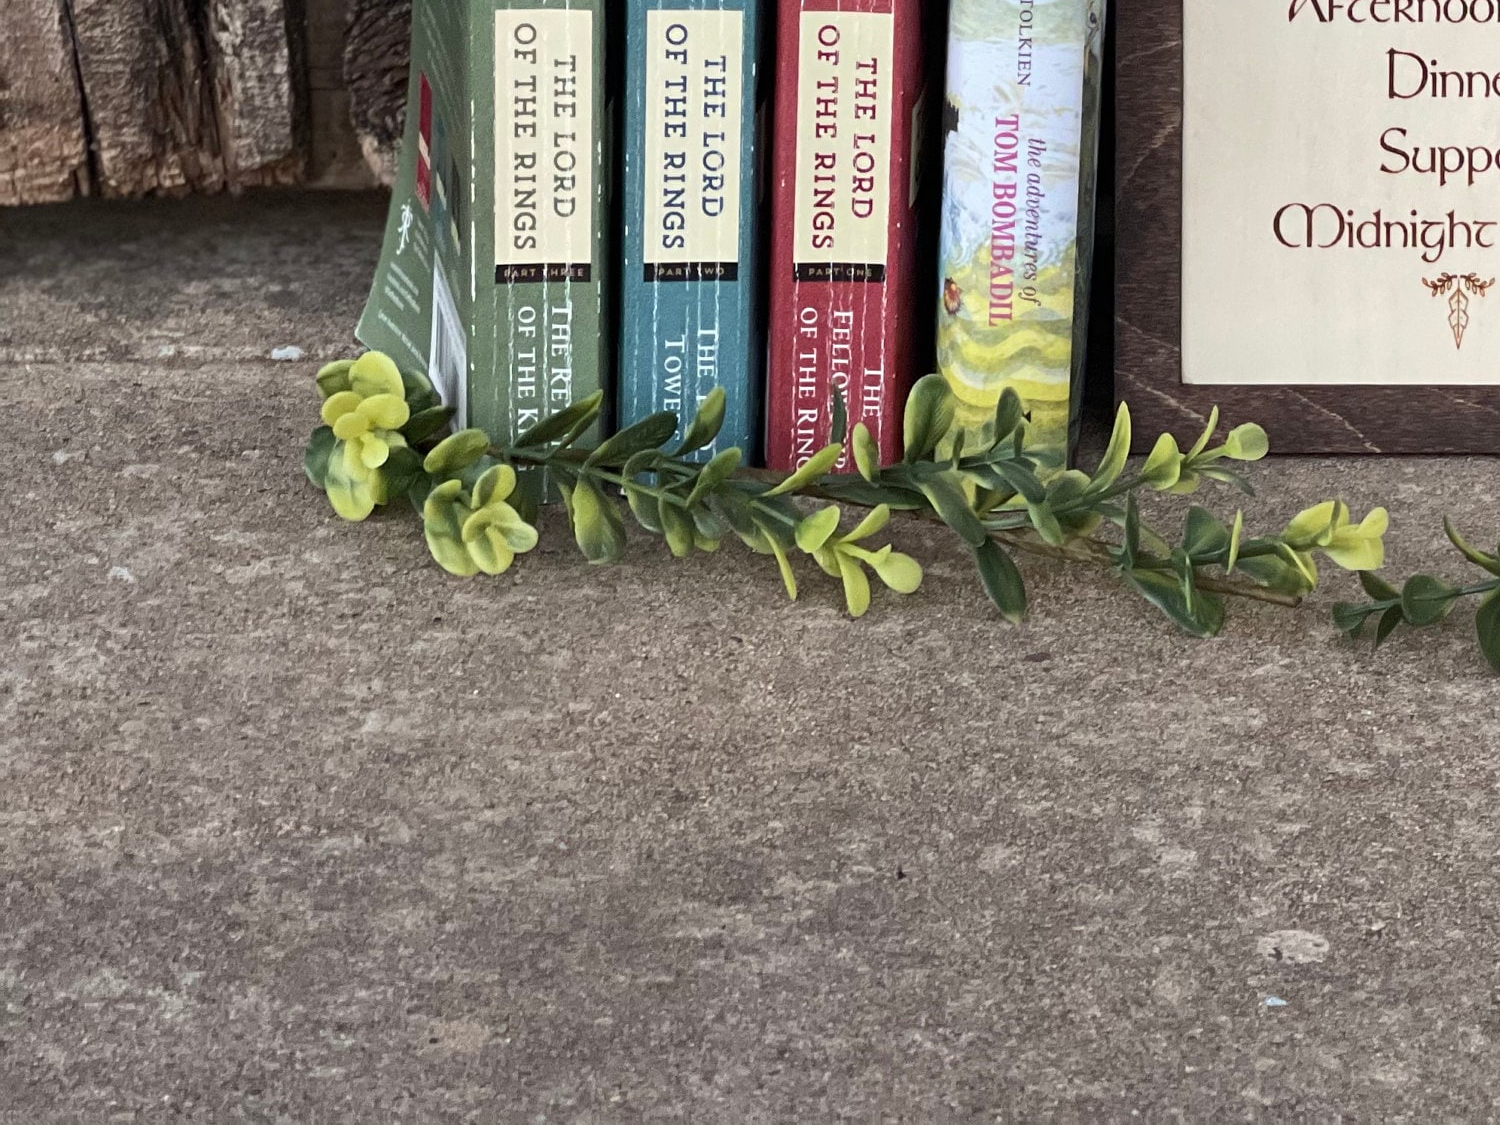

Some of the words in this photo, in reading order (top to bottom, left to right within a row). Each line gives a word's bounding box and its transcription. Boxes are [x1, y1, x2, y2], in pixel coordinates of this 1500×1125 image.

[513, 23, 537, 64] OF
[665, 23, 688, 65] OF
[817, 24, 841, 66] OF
[513, 75, 537, 138] THE
[553, 55, 577, 118] THE
[664, 75, 687, 138] THE
[703, 55, 727, 118] THE
[815, 76, 839, 139] THE
[854, 57, 878, 121] THE
[553, 131, 577, 218] LORD
[701, 131, 725, 217] LORD
[993, 113, 1020, 175] TOM
[1026, 137, 1047, 168] the
[513, 152, 537, 249] RINGS
[662, 152, 687, 249] RINGS
[812, 152, 837, 249] RINGS
[851, 133, 876, 219] LORD
[988, 181, 1018, 327] BOMBADIL
[1022, 171, 1046, 281] adventures
[1272, 202, 1498, 263] Midnight
[808, 267, 840, 276] PART
[1018, 285, 1042, 307] of
[517, 306, 536, 338] OF
[551, 301, 573, 357] THE
[800, 307, 818, 339] OF
[517, 346, 536, 399] THE
[697, 329, 719, 378] THE
[798, 347, 817, 399] THE
[663, 334, 686, 441] TOWE
[862, 367, 885, 418] THE
